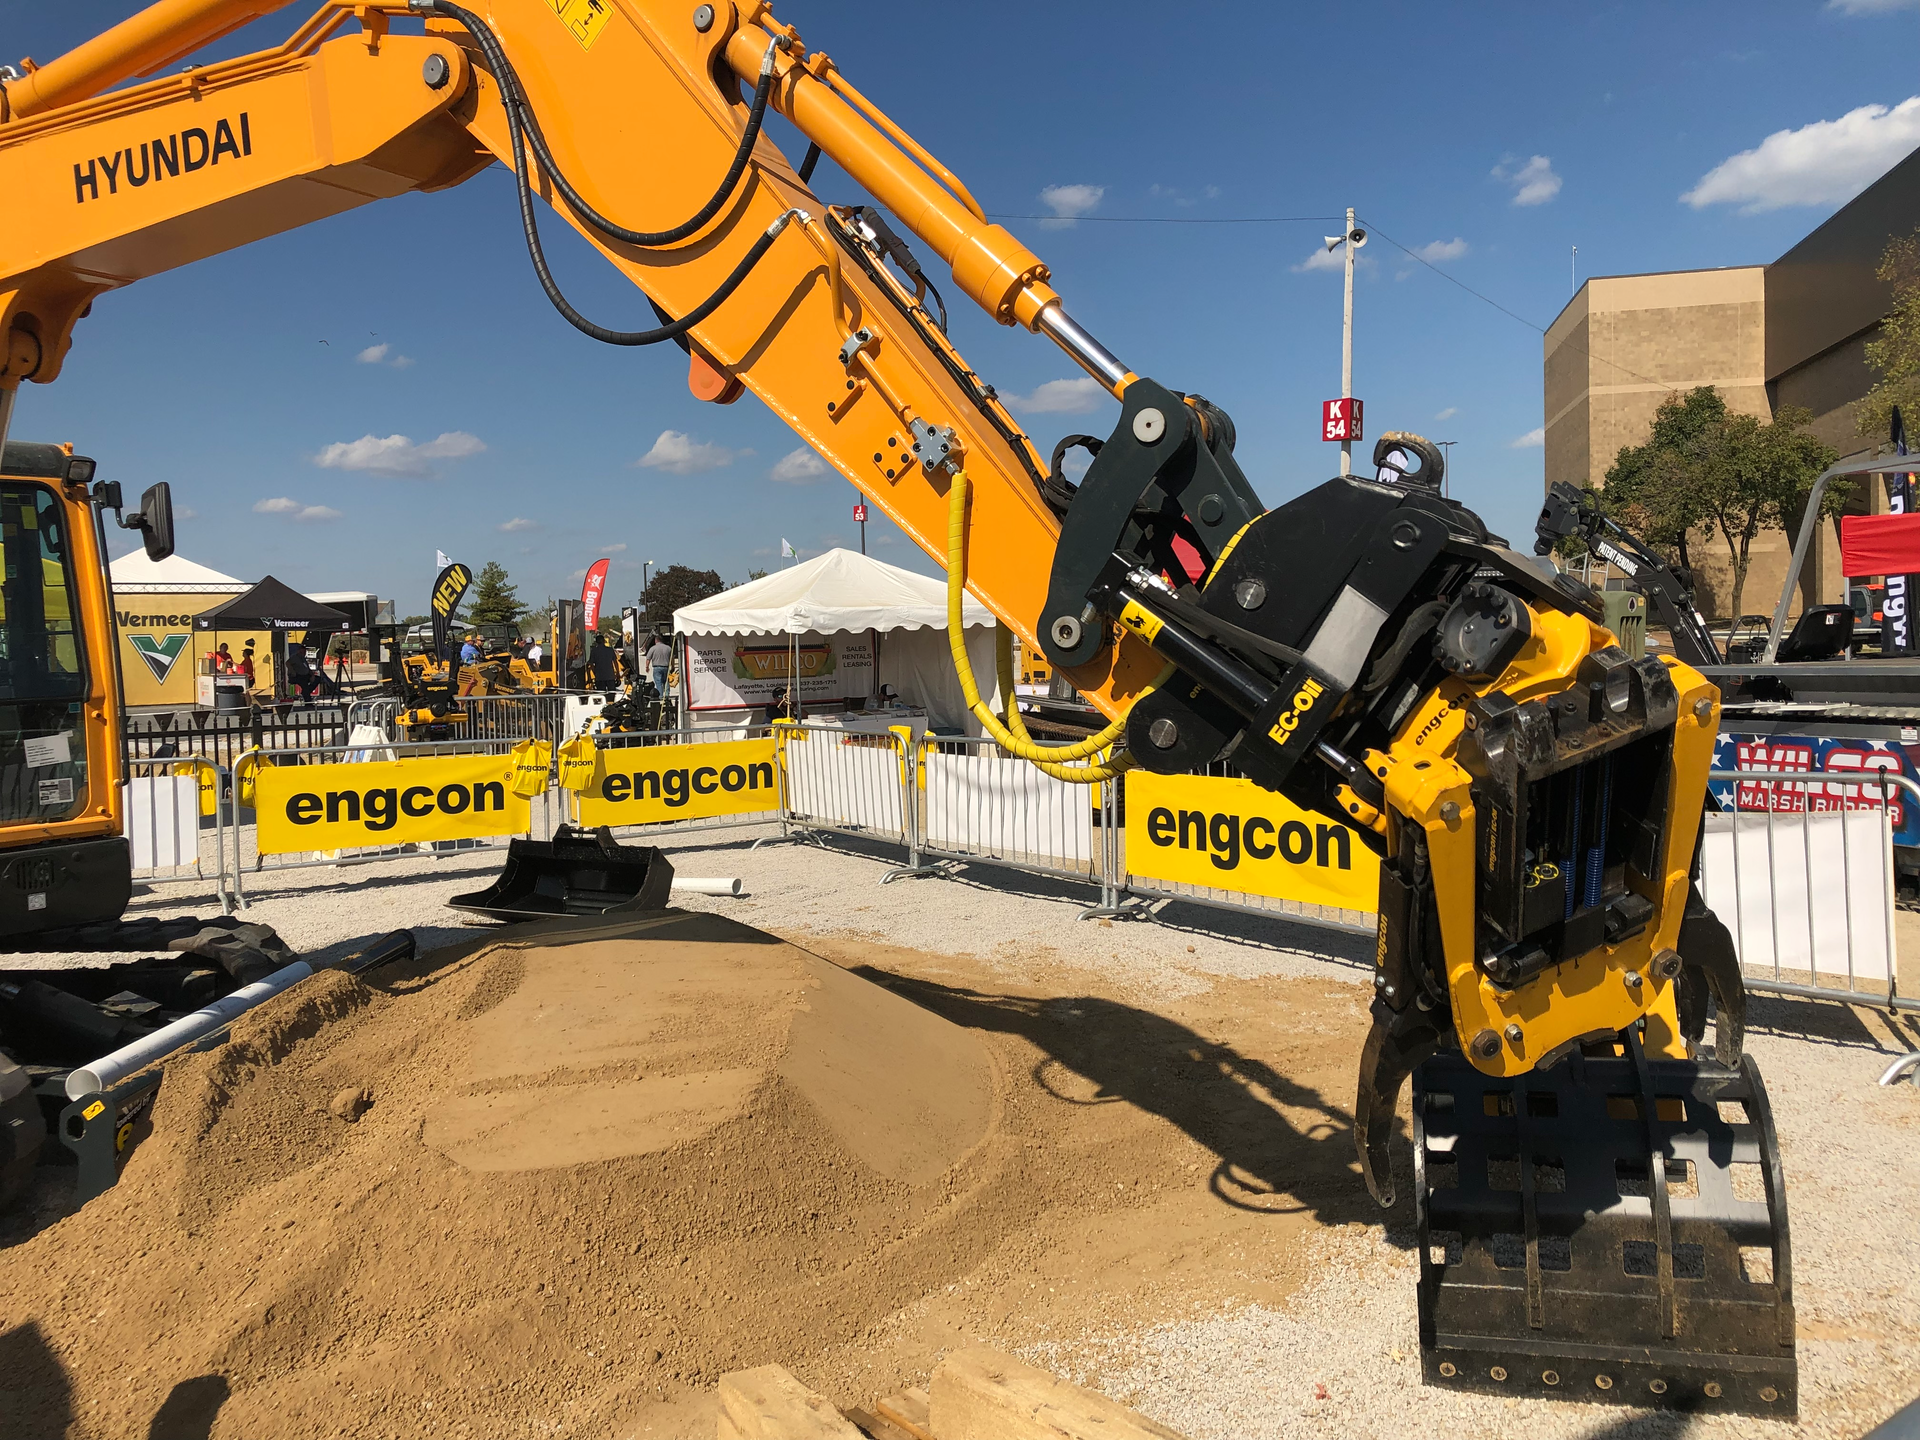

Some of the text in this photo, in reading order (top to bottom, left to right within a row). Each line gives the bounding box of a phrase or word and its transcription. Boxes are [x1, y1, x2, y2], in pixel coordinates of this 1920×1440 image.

[73, 112, 252, 204] HYUNDAI
[1330, 400, 1343, 419] K
[1353, 400, 1360, 419] K
[1326, 419, 1346, 439] 54
[1351, 420, 1361, 438] 54
[1597, 541, 1639, 576] PATENT PENDING
[433, 565, 468, 618] NEW
[584, 590, 598, 627] Bobcat
[115, 611, 191, 627] Vermee
[274, 618, 310, 628] Vermeer
[693, 657, 727, 665] REPAIRS
[697, 649, 723, 657] PARTS
[753, 653, 817, 670] WILCO
[843, 660, 872, 668] LEASING
[1268, 676, 1324, 745] EC-Oil
[1415, 692, 1470, 747] engcon
[516, 764, 548, 773] engcon
[601, 762, 774, 808] engcon
[1739, 791, 1805, 811] MARSH
[1147, 806, 1352, 871] engcon
[1376, 913, 1389, 968] engcon
